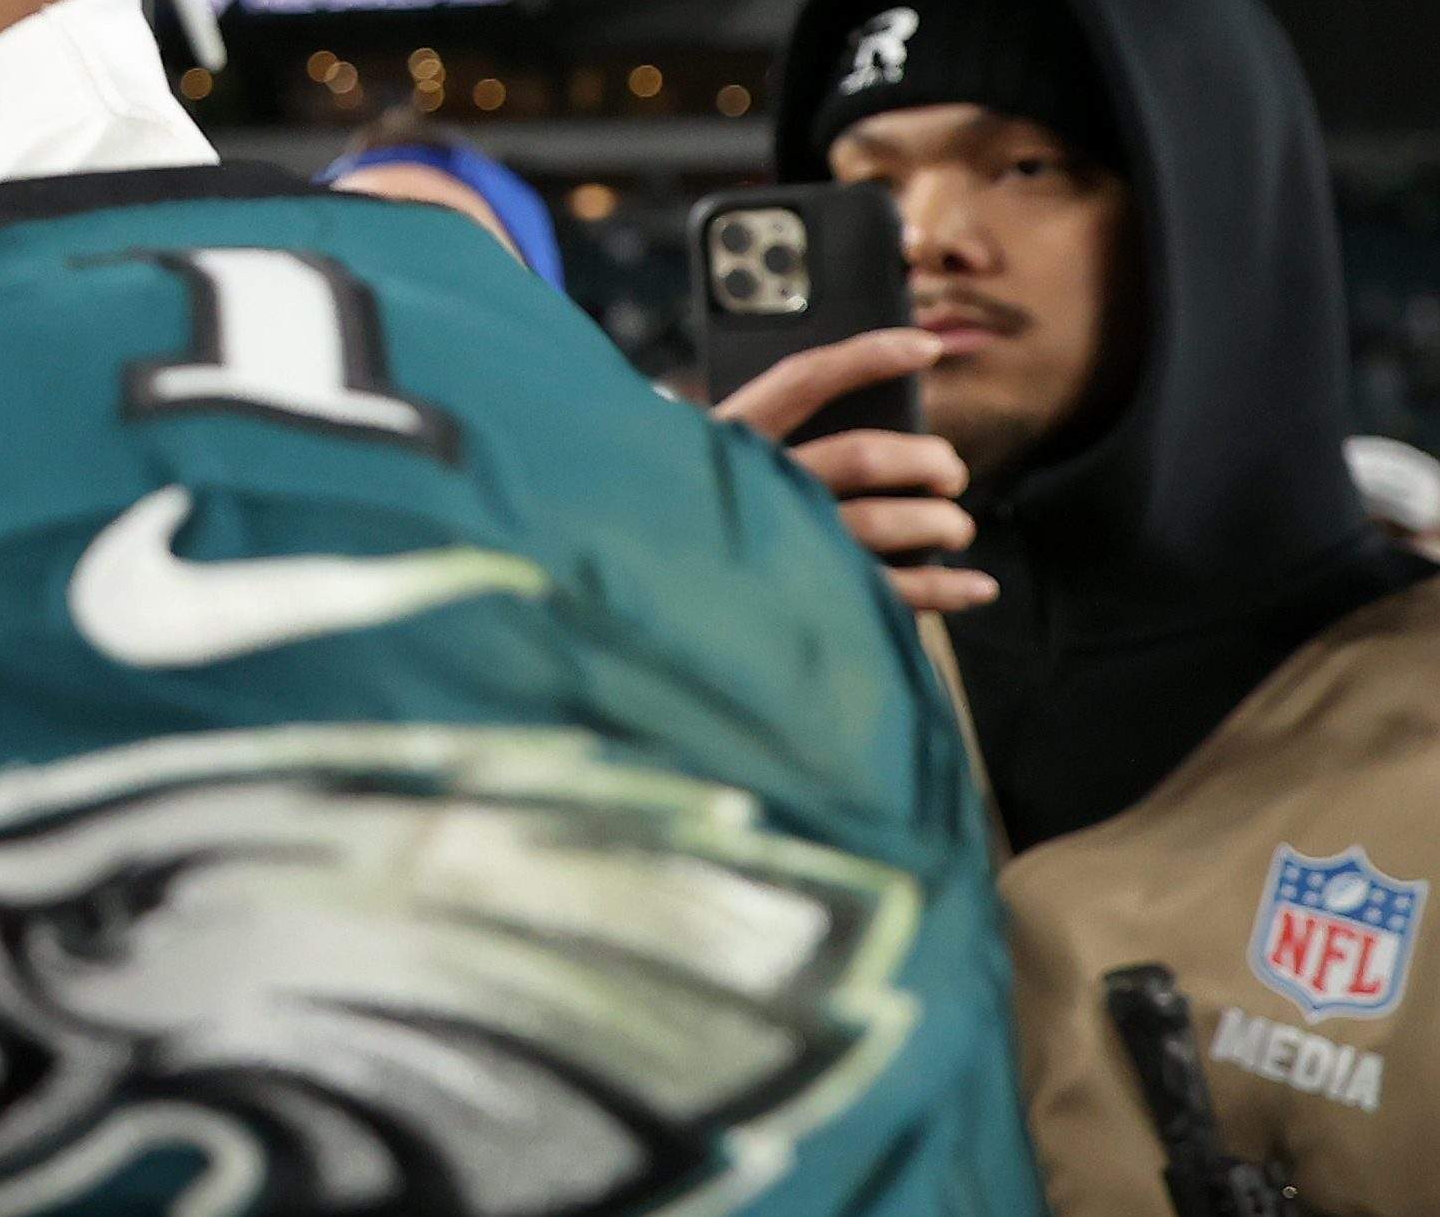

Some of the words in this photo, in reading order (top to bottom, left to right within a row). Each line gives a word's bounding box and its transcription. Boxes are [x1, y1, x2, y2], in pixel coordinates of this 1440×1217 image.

[124, 246, 454, 458] 1
[1269, 911, 1383, 994] NFL
[1211, 1006, 1384, 1113] MEDIA
